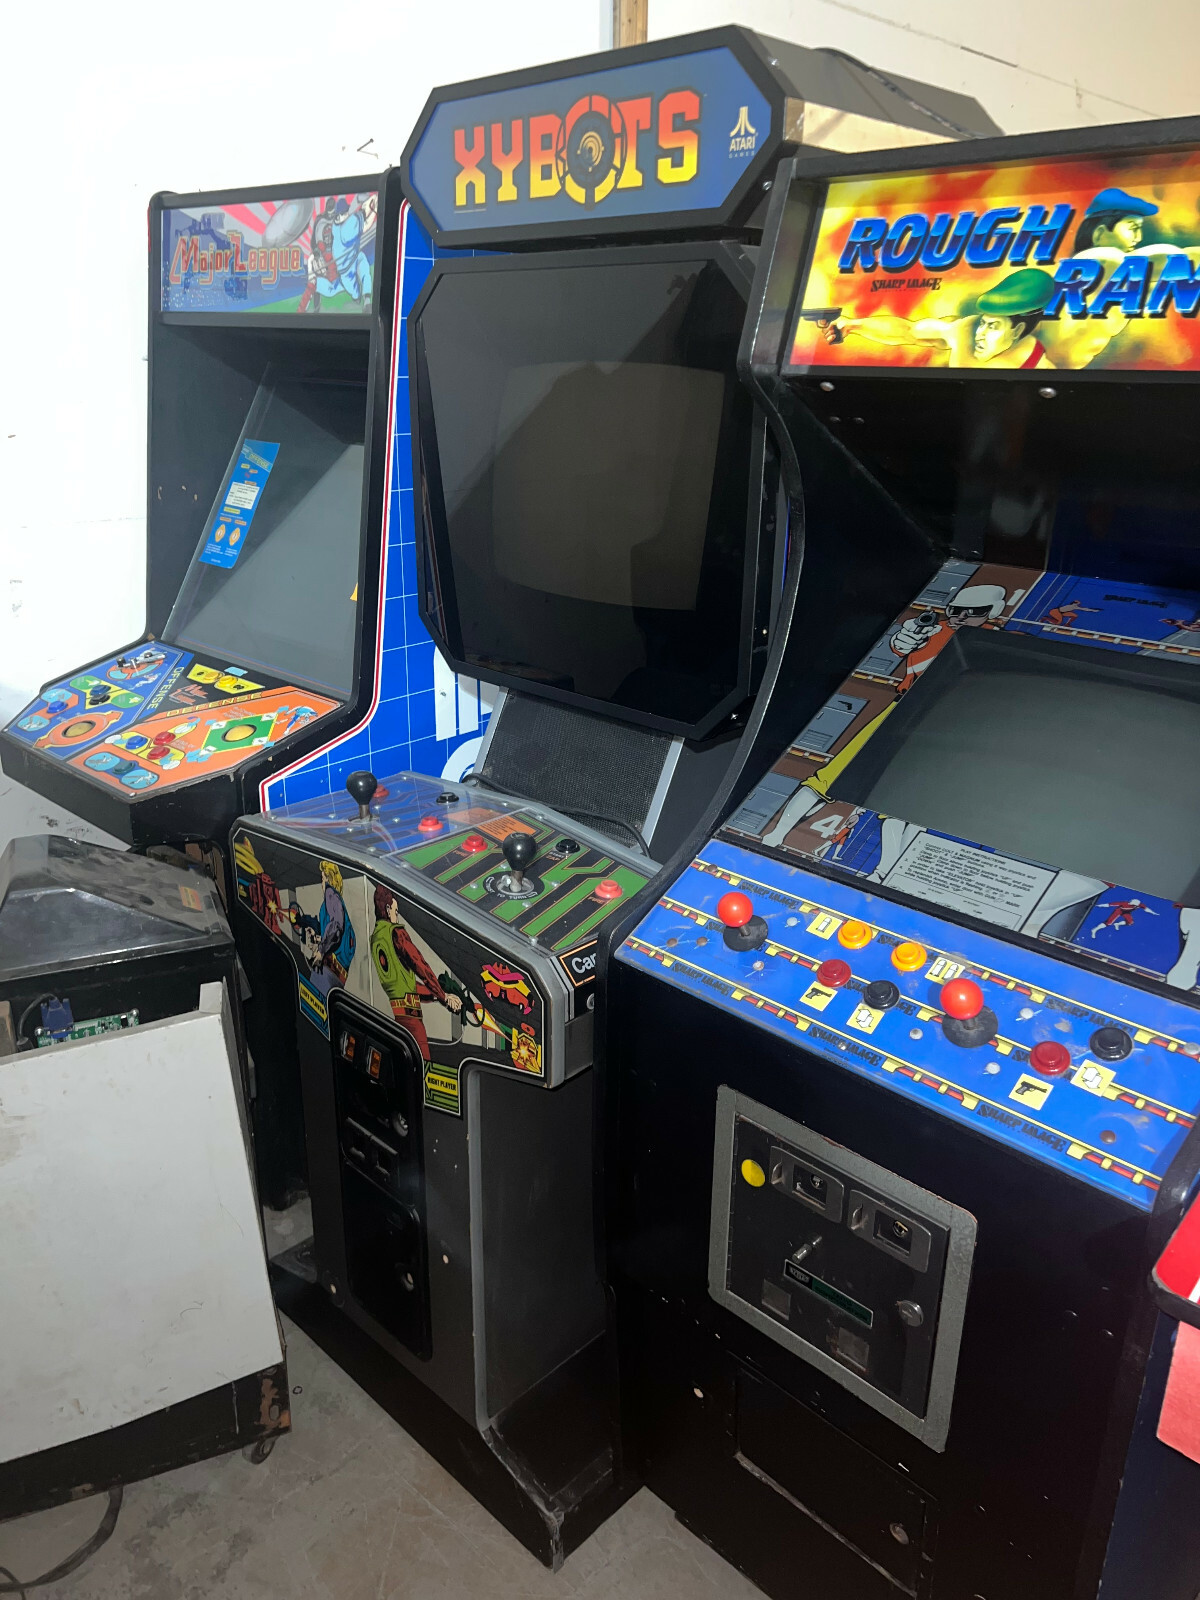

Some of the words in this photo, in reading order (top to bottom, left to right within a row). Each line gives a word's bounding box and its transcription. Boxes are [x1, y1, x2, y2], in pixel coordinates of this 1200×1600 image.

[453, 90, 700, 206] XYBOTS
[729, 135, 756, 153] ATARI
[169, 234, 232, 285] Major
[227, 230, 304, 286] League
[838, 203, 1073, 271] ROUGH
[147, 666, 185, 710] OFFENSE
[166, 692, 262, 717] DEFENSE
